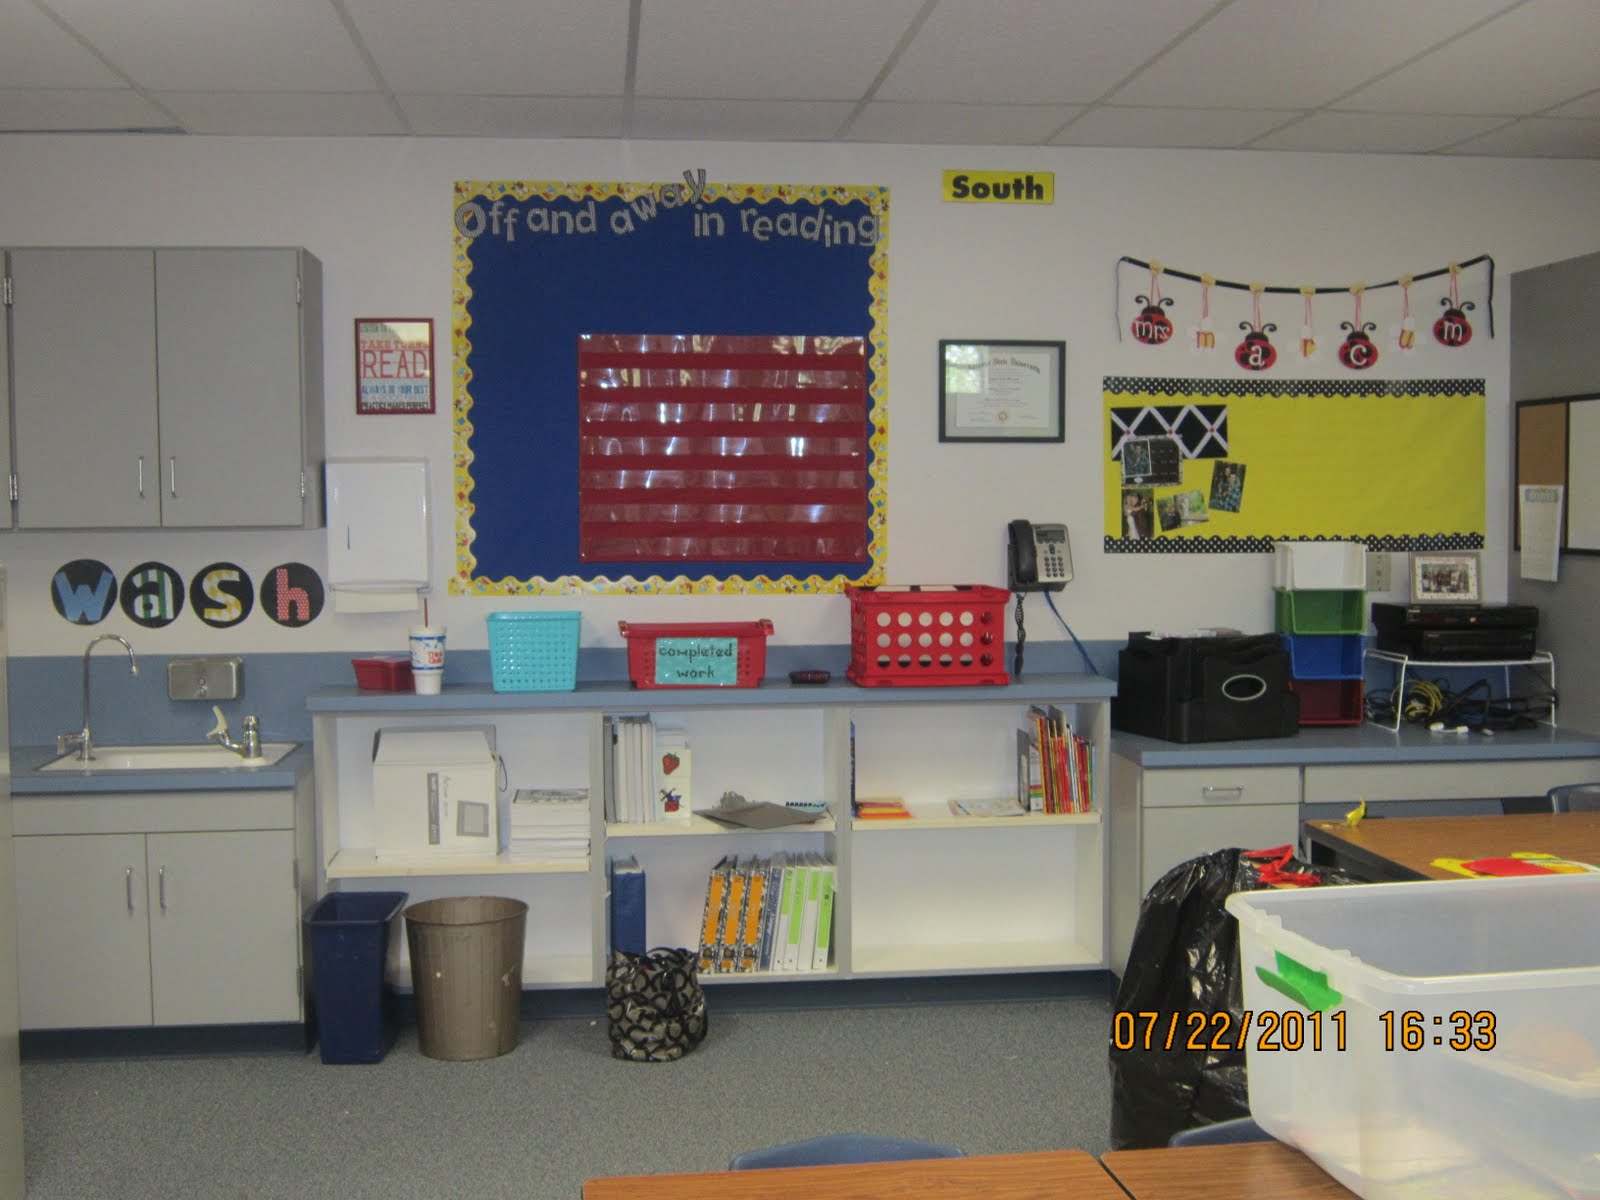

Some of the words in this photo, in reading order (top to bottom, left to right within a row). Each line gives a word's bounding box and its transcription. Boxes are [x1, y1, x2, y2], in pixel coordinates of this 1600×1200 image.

[952, 175, 1044, 200] South
[455, 201, 517, 241] Off
[527, 201, 597, 234] and
[610, 168, 707, 234] away
[694, 203, 725, 237] in
[741, 207, 880, 248] reading
[1134, 320, 1170, 341] mrs
[363, 350, 428, 378] READ
[362, 385, 386, 395] ALWAYS
[414, 385, 428, 394] BEST
[658, 643, 734, 663] completed
[676, 665, 715, 678] work
